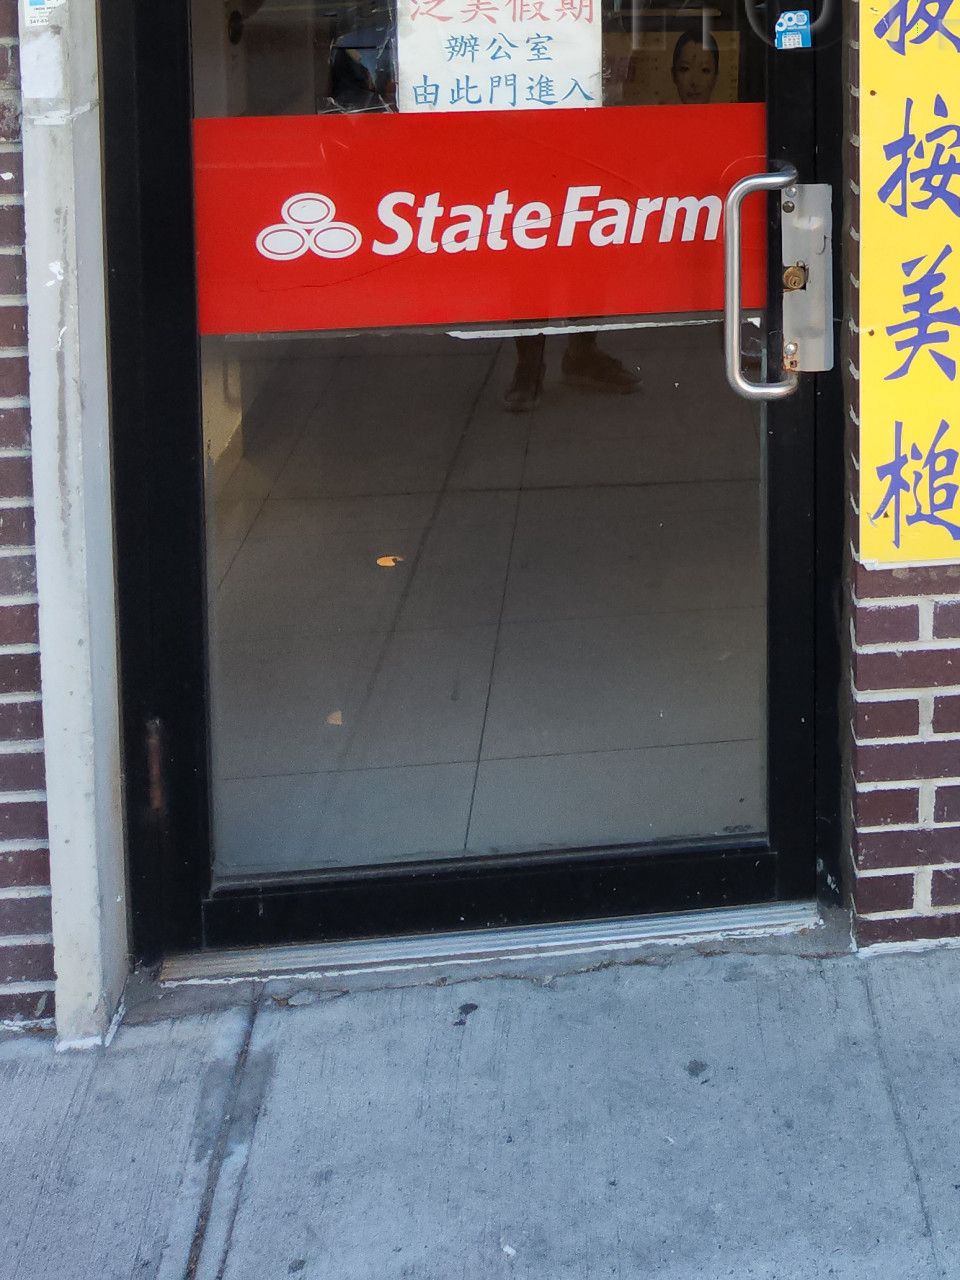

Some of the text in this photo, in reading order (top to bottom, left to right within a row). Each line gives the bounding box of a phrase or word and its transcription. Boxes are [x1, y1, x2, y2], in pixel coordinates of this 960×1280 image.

[444, 32, 554, 64] 辦公室
[412, 73, 596, 108] 由此門進入
